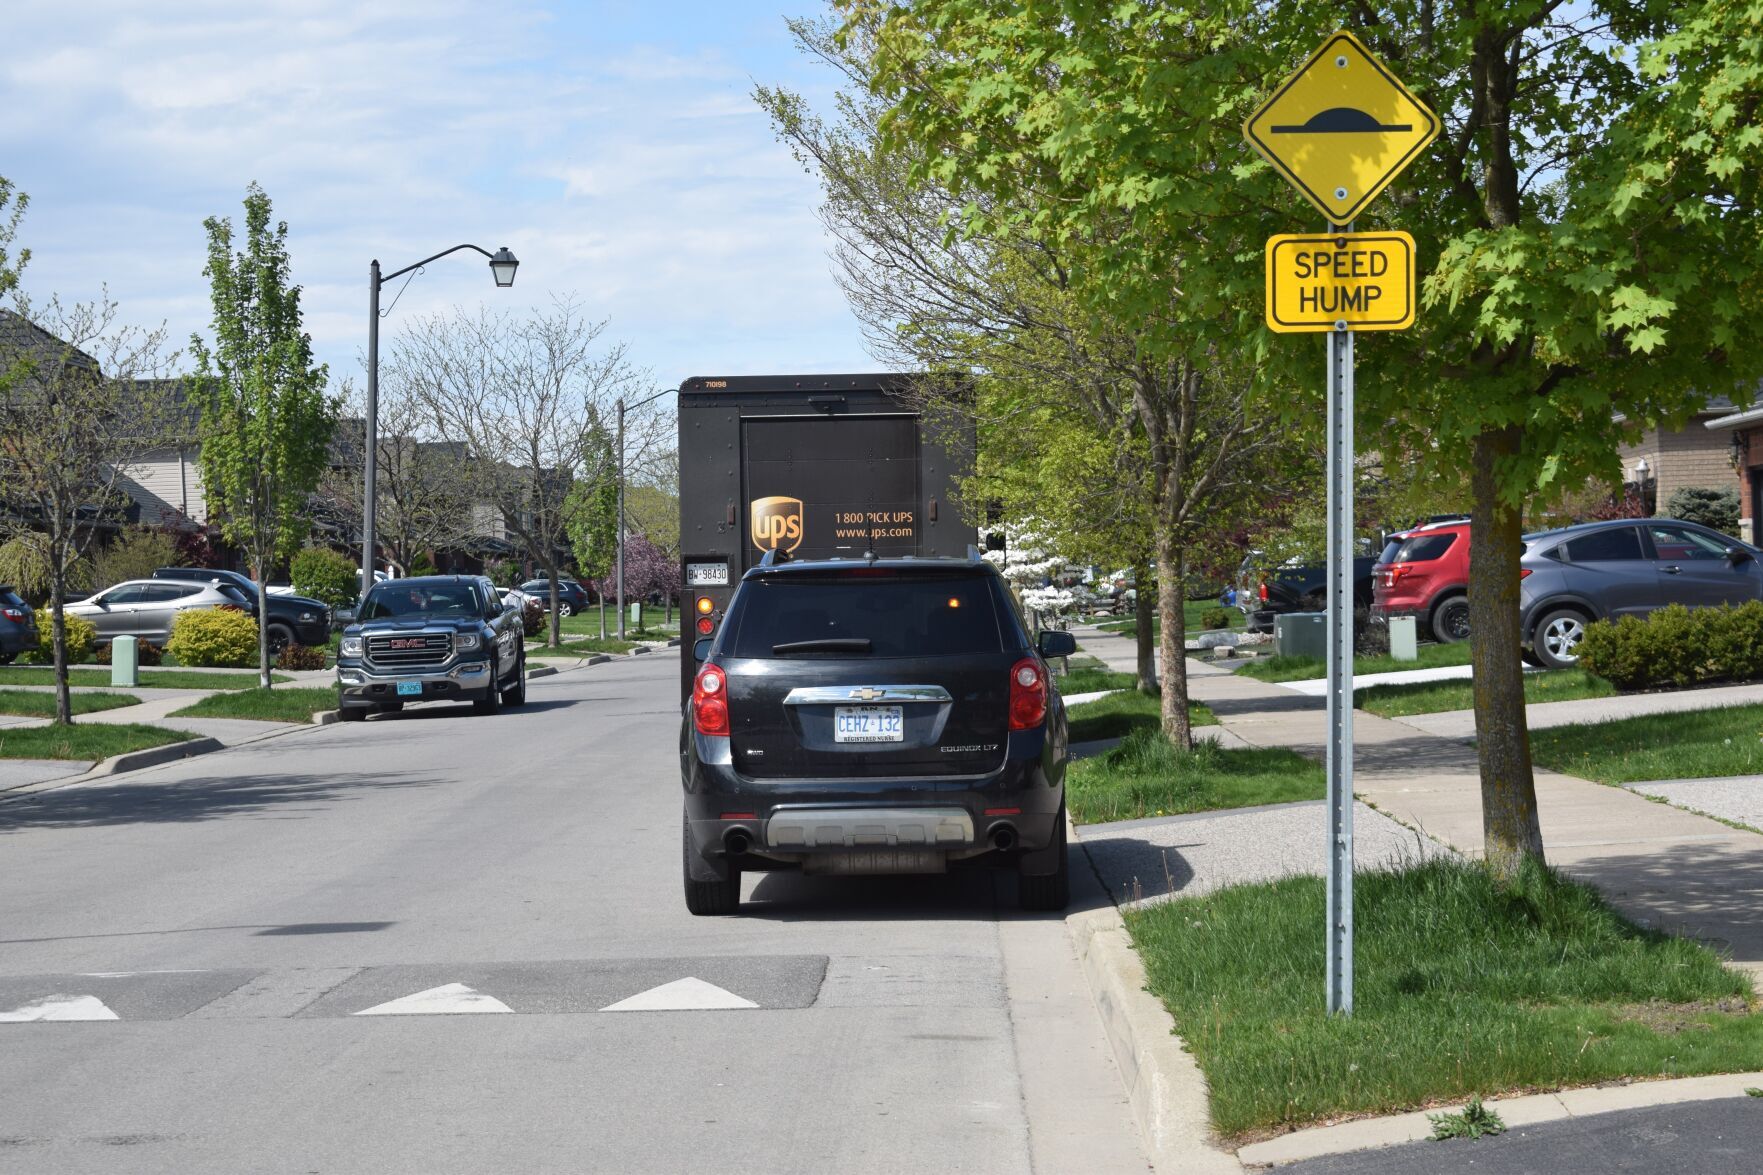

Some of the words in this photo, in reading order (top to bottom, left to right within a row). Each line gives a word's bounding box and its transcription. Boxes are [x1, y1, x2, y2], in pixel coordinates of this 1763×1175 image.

[1294, 250, 1388, 279] SPEED
[1300, 285, 1382, 313] HUMP
[843, 512, 864, 524] 800
[866, 512, 890, 523] PICK
[893, 511, 913, 523] UPS
[755, 514, 800, 548] ups
[835, 528, 913, 540] www.ups.com
[878, 714, 900, 732] 132
